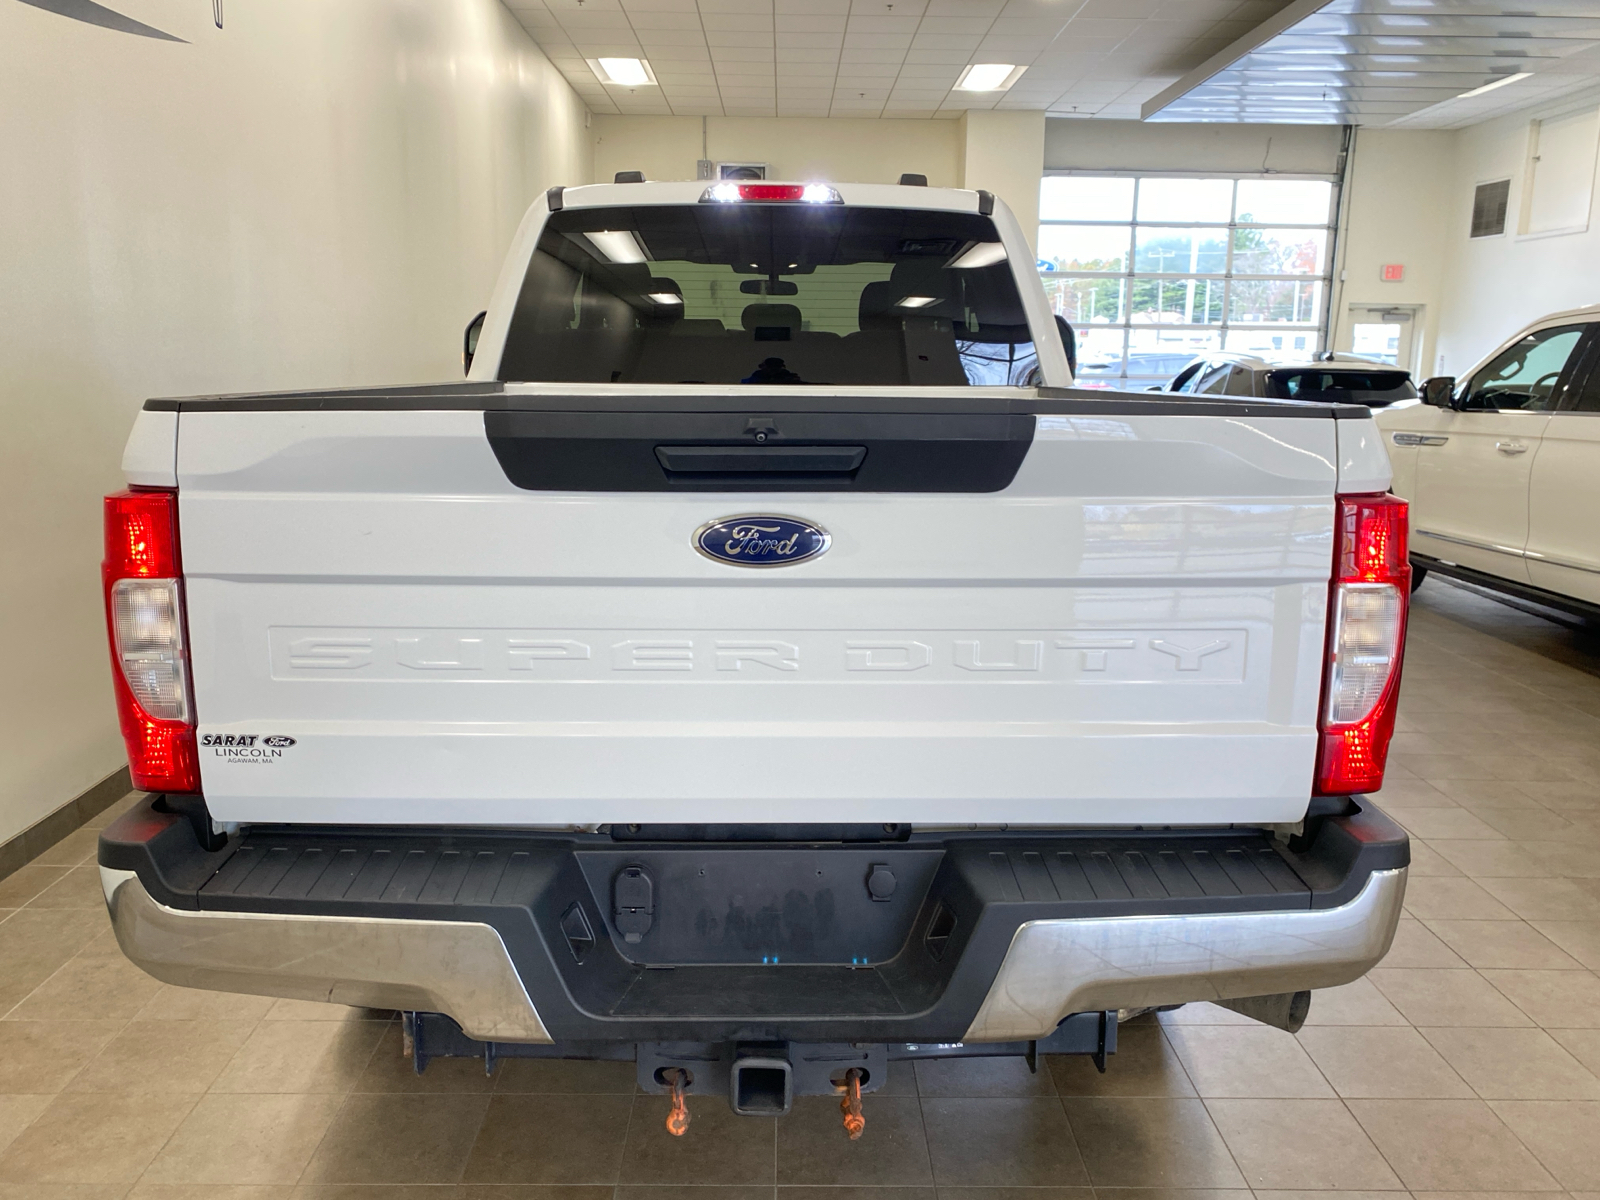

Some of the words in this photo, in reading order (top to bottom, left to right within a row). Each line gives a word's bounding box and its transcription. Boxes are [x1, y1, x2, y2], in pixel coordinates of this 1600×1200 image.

[724, 524, 799, 555] Ford
[290, 638, 799, 671] SUPER
[845, 640, 1230, 672] DUTY
[201, 733, 259, 747] SARAT
[215, 748, 282, 757] LINCOLN
